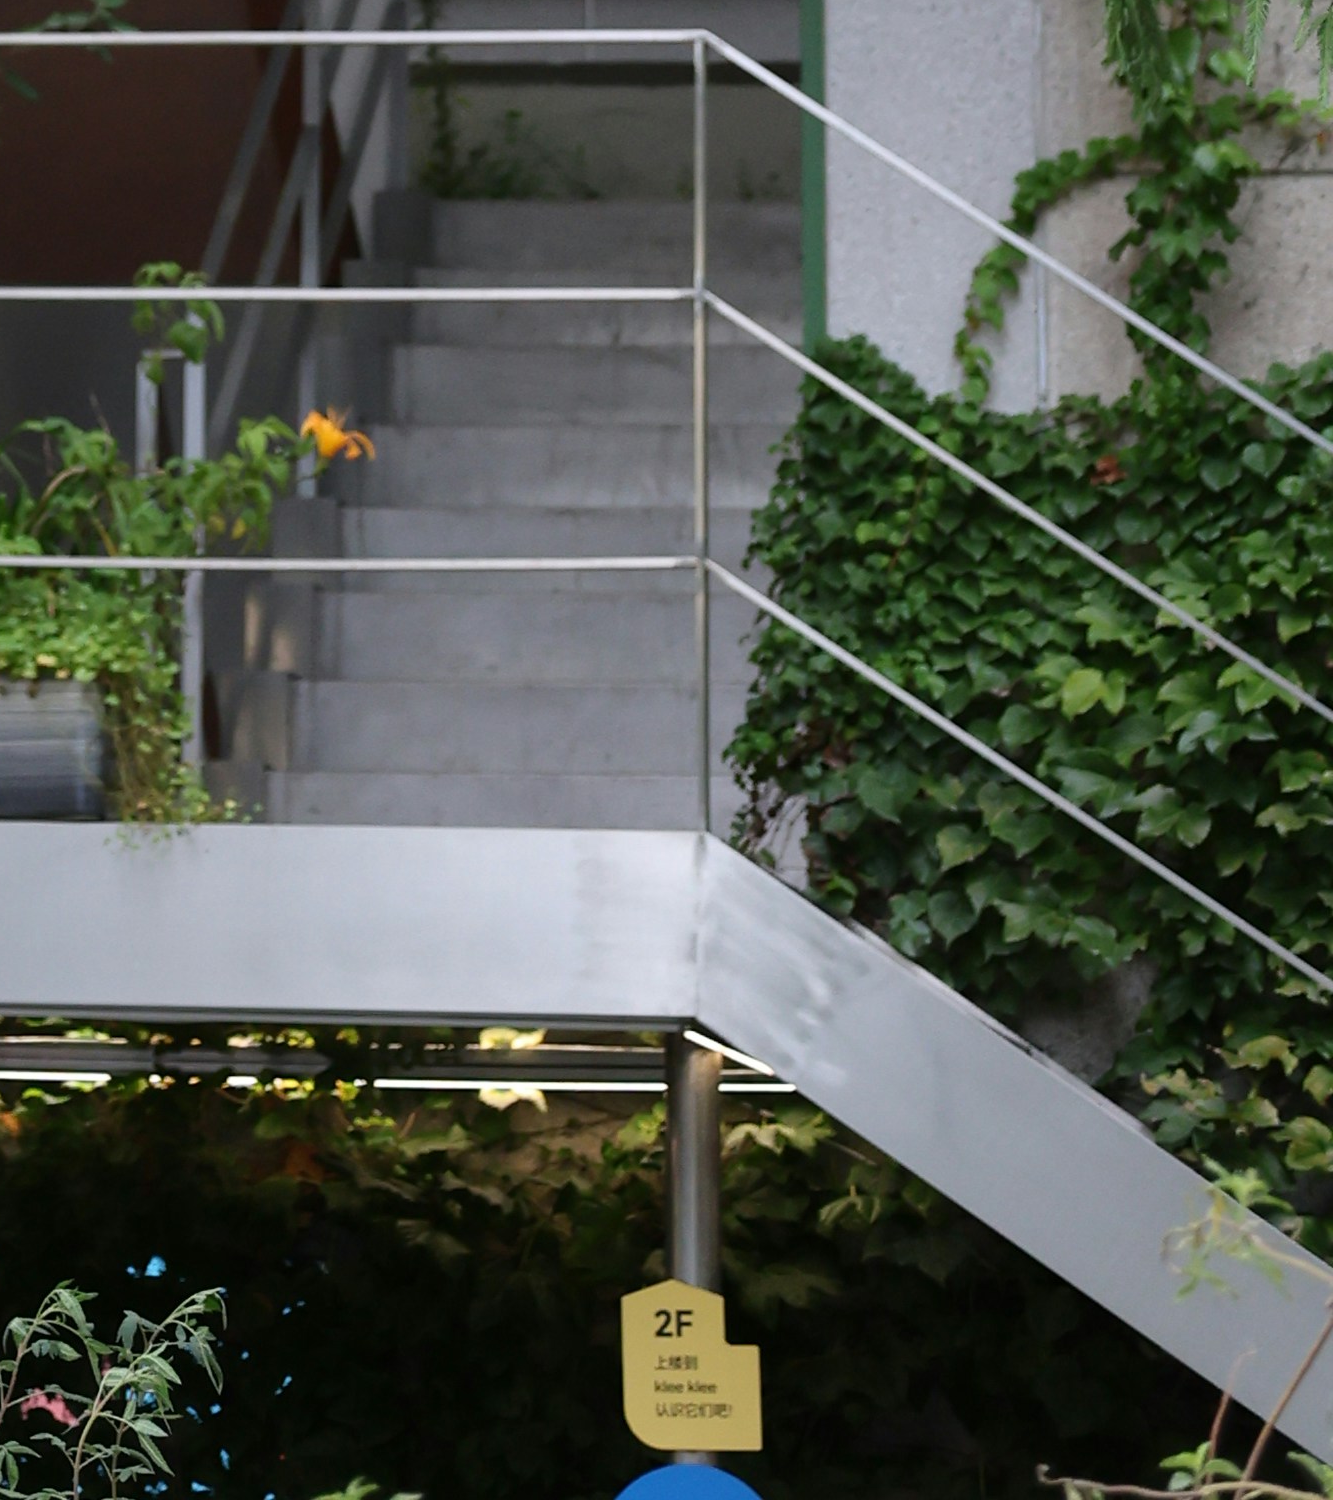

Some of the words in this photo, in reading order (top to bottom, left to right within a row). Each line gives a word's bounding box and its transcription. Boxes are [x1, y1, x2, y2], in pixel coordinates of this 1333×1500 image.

[654, 1308, 694, 1338] 2F
[653, 1380, 684, 1394] klee
[687, 1380, 718, 1394] klee
